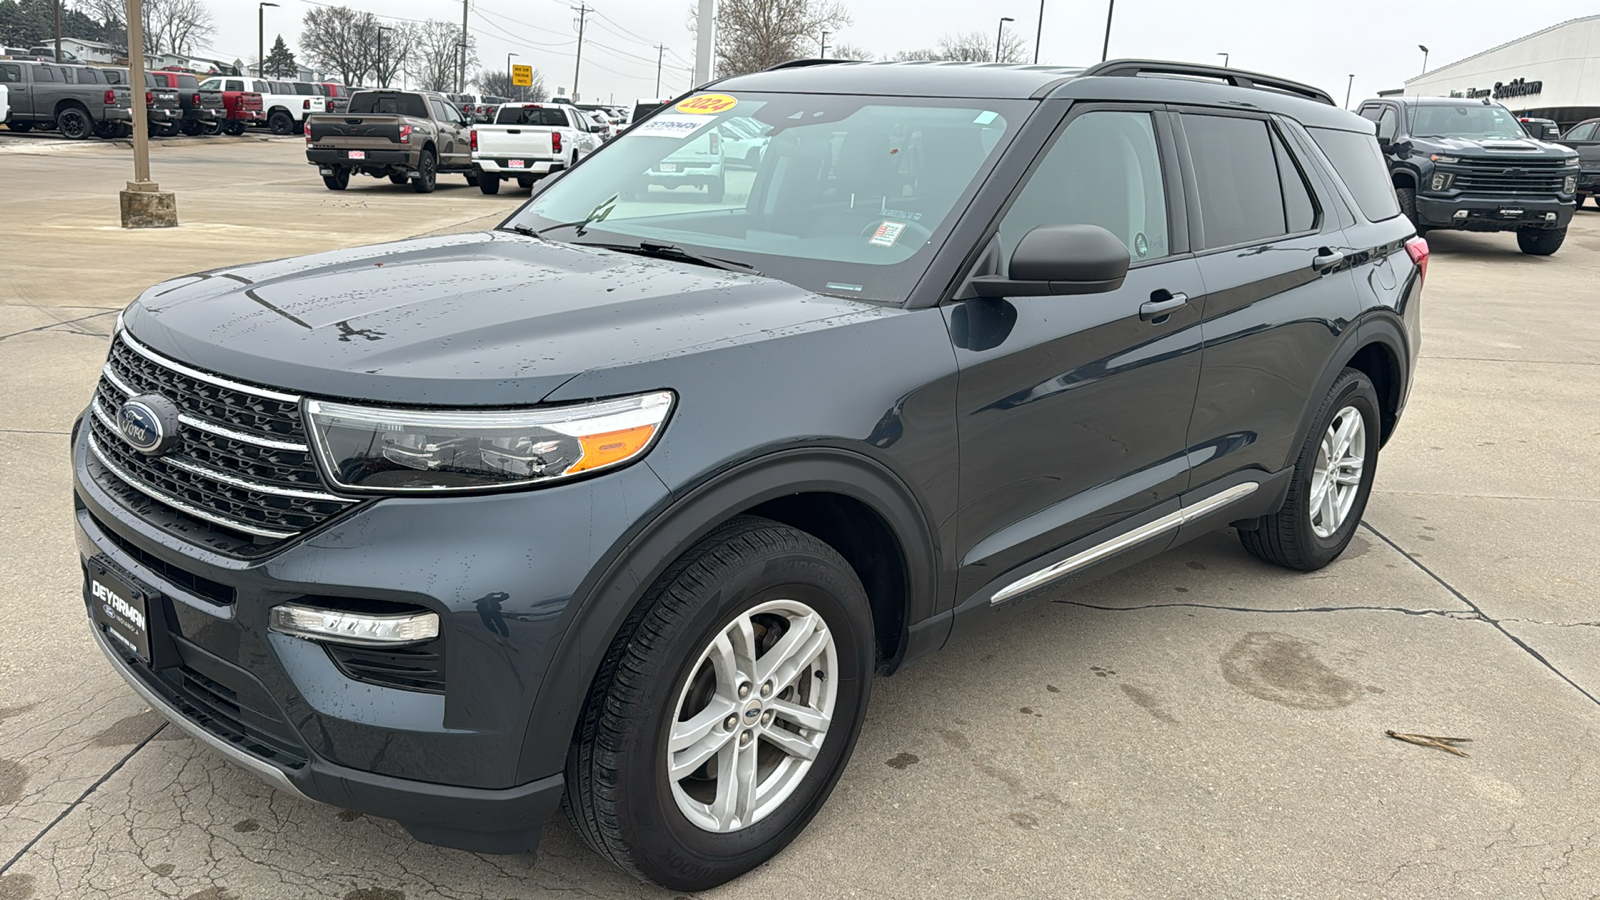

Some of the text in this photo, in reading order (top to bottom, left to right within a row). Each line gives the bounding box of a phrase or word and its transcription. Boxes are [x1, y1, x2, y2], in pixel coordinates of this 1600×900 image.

[1492, 77, 1542, 99] Southtown
[680, 97, 733, 111] 2024
[122, 410, 147, 441] Ford
[92, 580, 145, 631] DEYARMAN
